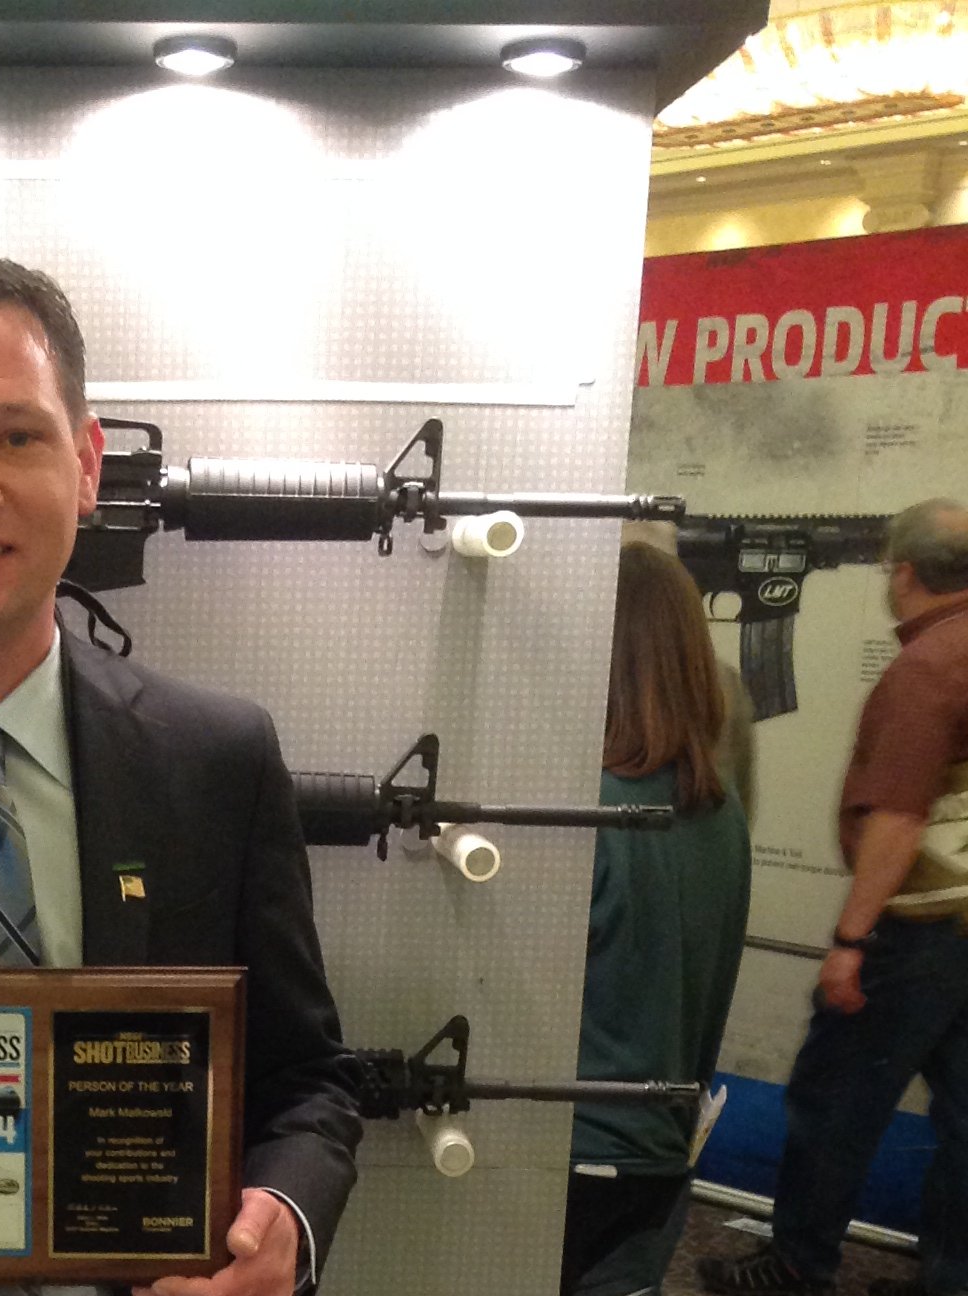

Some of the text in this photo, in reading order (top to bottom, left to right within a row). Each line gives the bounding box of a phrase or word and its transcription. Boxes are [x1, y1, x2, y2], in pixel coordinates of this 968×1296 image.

[693, 296, 968, 385] PRODUC
[764, 585, 794, 599] LMT
[68, 1080, 194, 1092] PERSON OF THE YEAR
[142, 1216, 194, 1227] BONNIER
